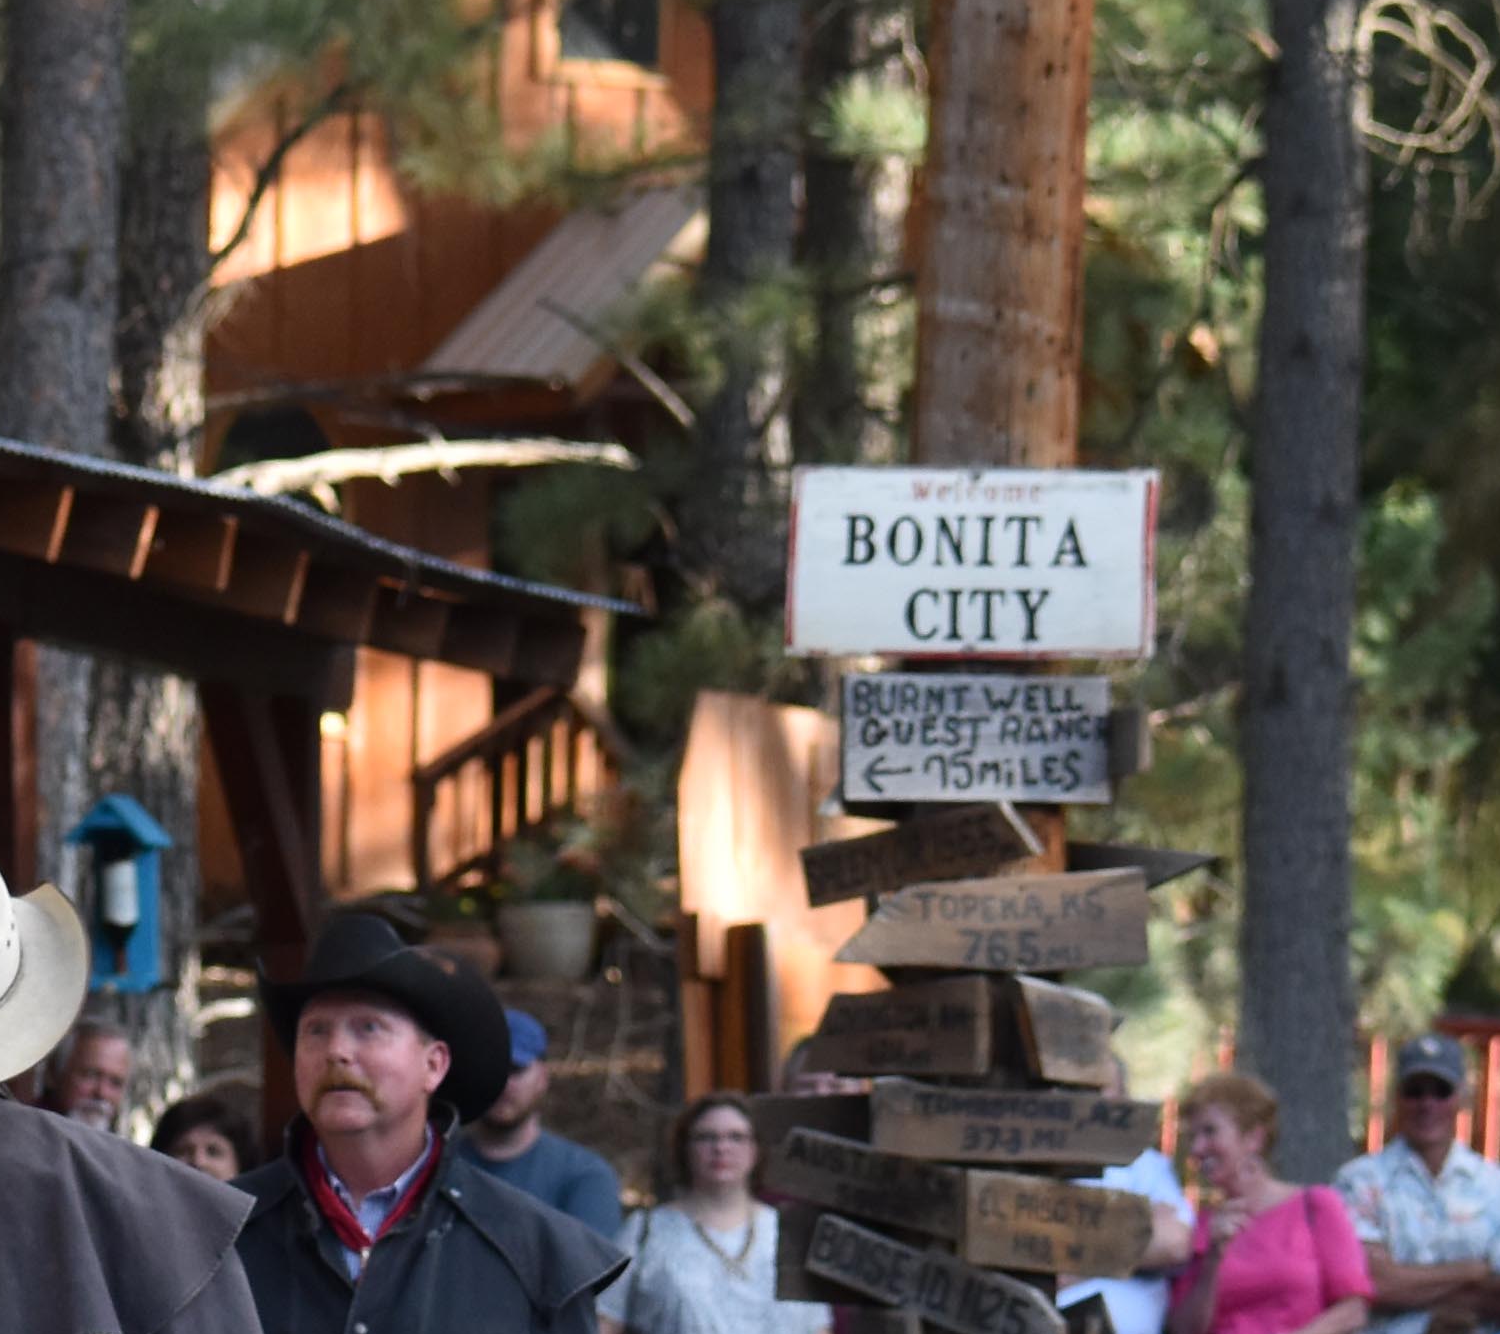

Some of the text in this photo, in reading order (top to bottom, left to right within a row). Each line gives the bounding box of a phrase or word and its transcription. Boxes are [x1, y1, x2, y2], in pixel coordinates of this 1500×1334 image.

[911, 476, 1042, 502] Welcome
[842, 514, 1088, 567] BONITA
[904, 587, 1051, 642] CITY
[852, 679, 1084, 717] BURNT WELL
[860, 714, 1109, 750] GUEST RANCH
[959, 928, 1040, 967] 765
[1088, 1102, 1134, 1131] AZ
